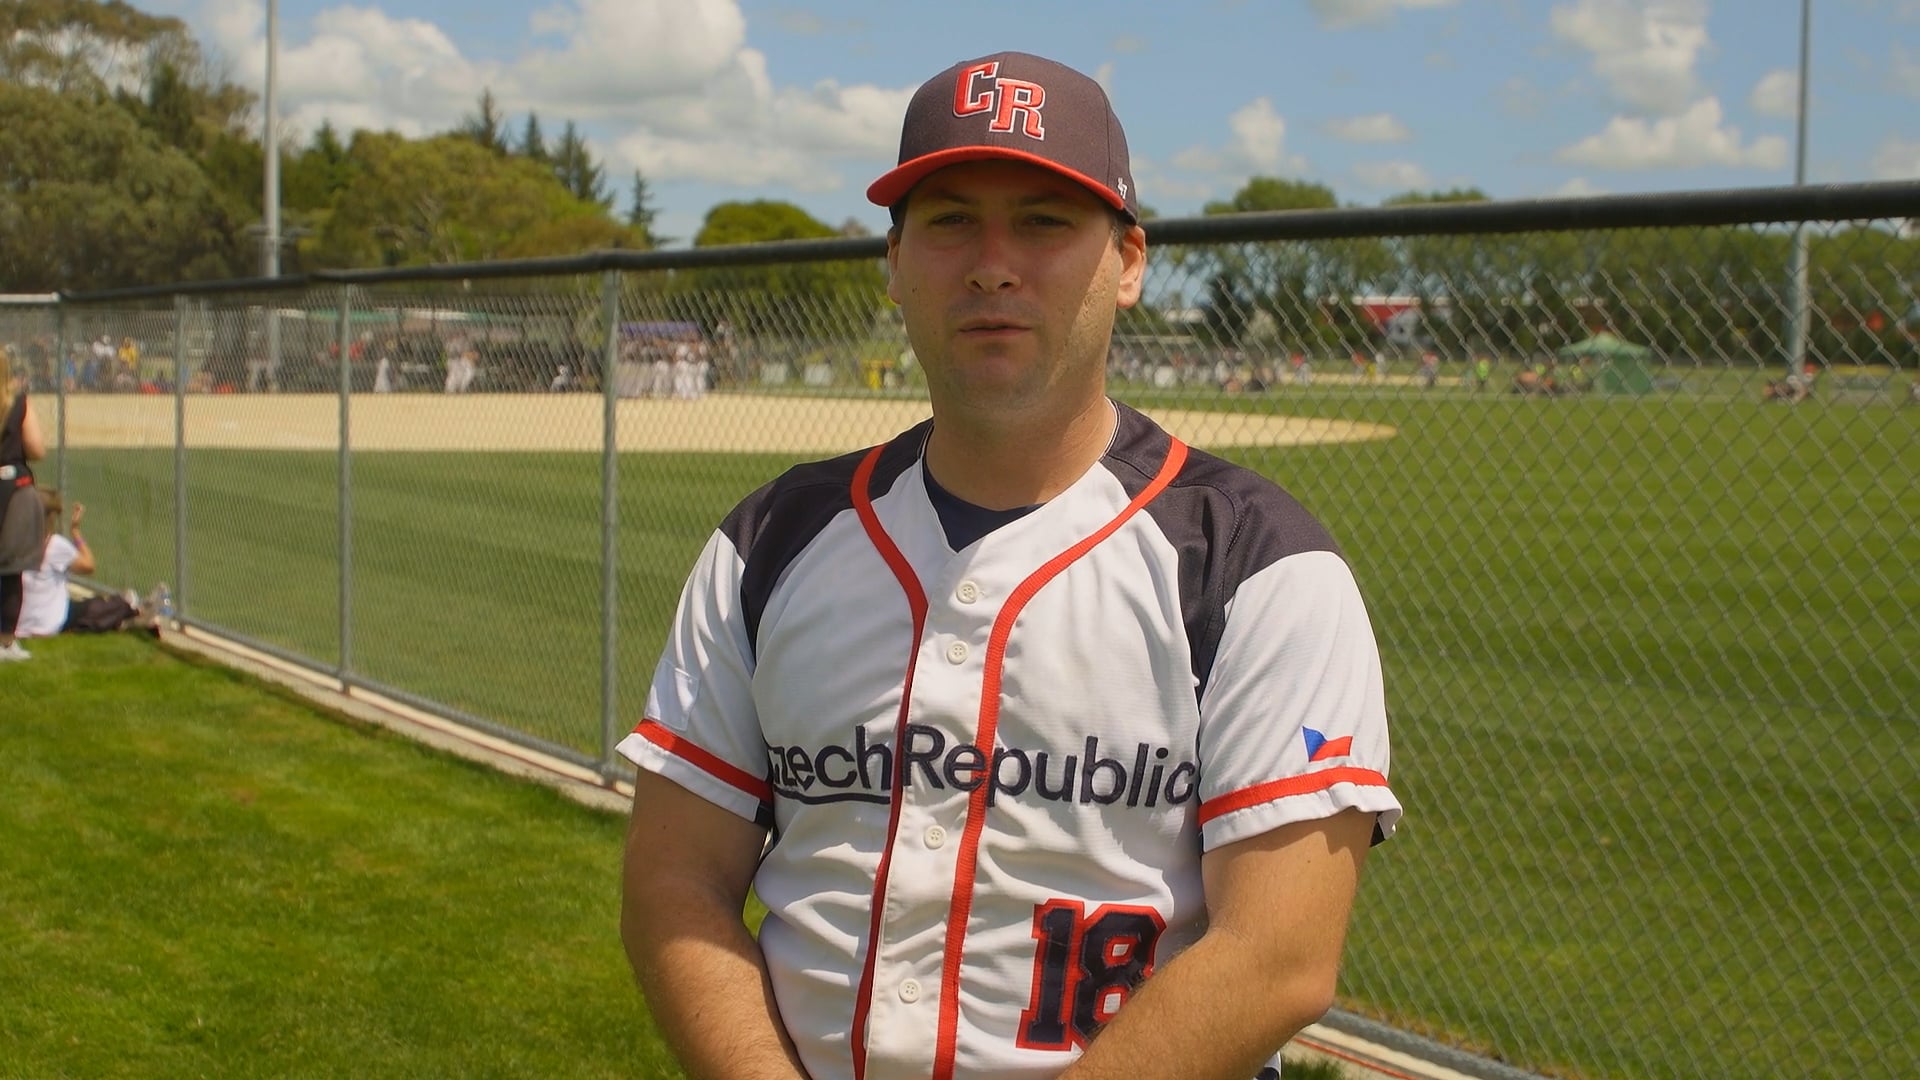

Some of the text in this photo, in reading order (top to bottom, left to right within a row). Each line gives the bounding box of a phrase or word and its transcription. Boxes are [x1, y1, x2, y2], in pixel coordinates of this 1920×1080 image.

[953, 61, 1045, 141] CR
[766, 724, 1196, 807] zech Republic
[1016, 898, 1168, 1051] 18
